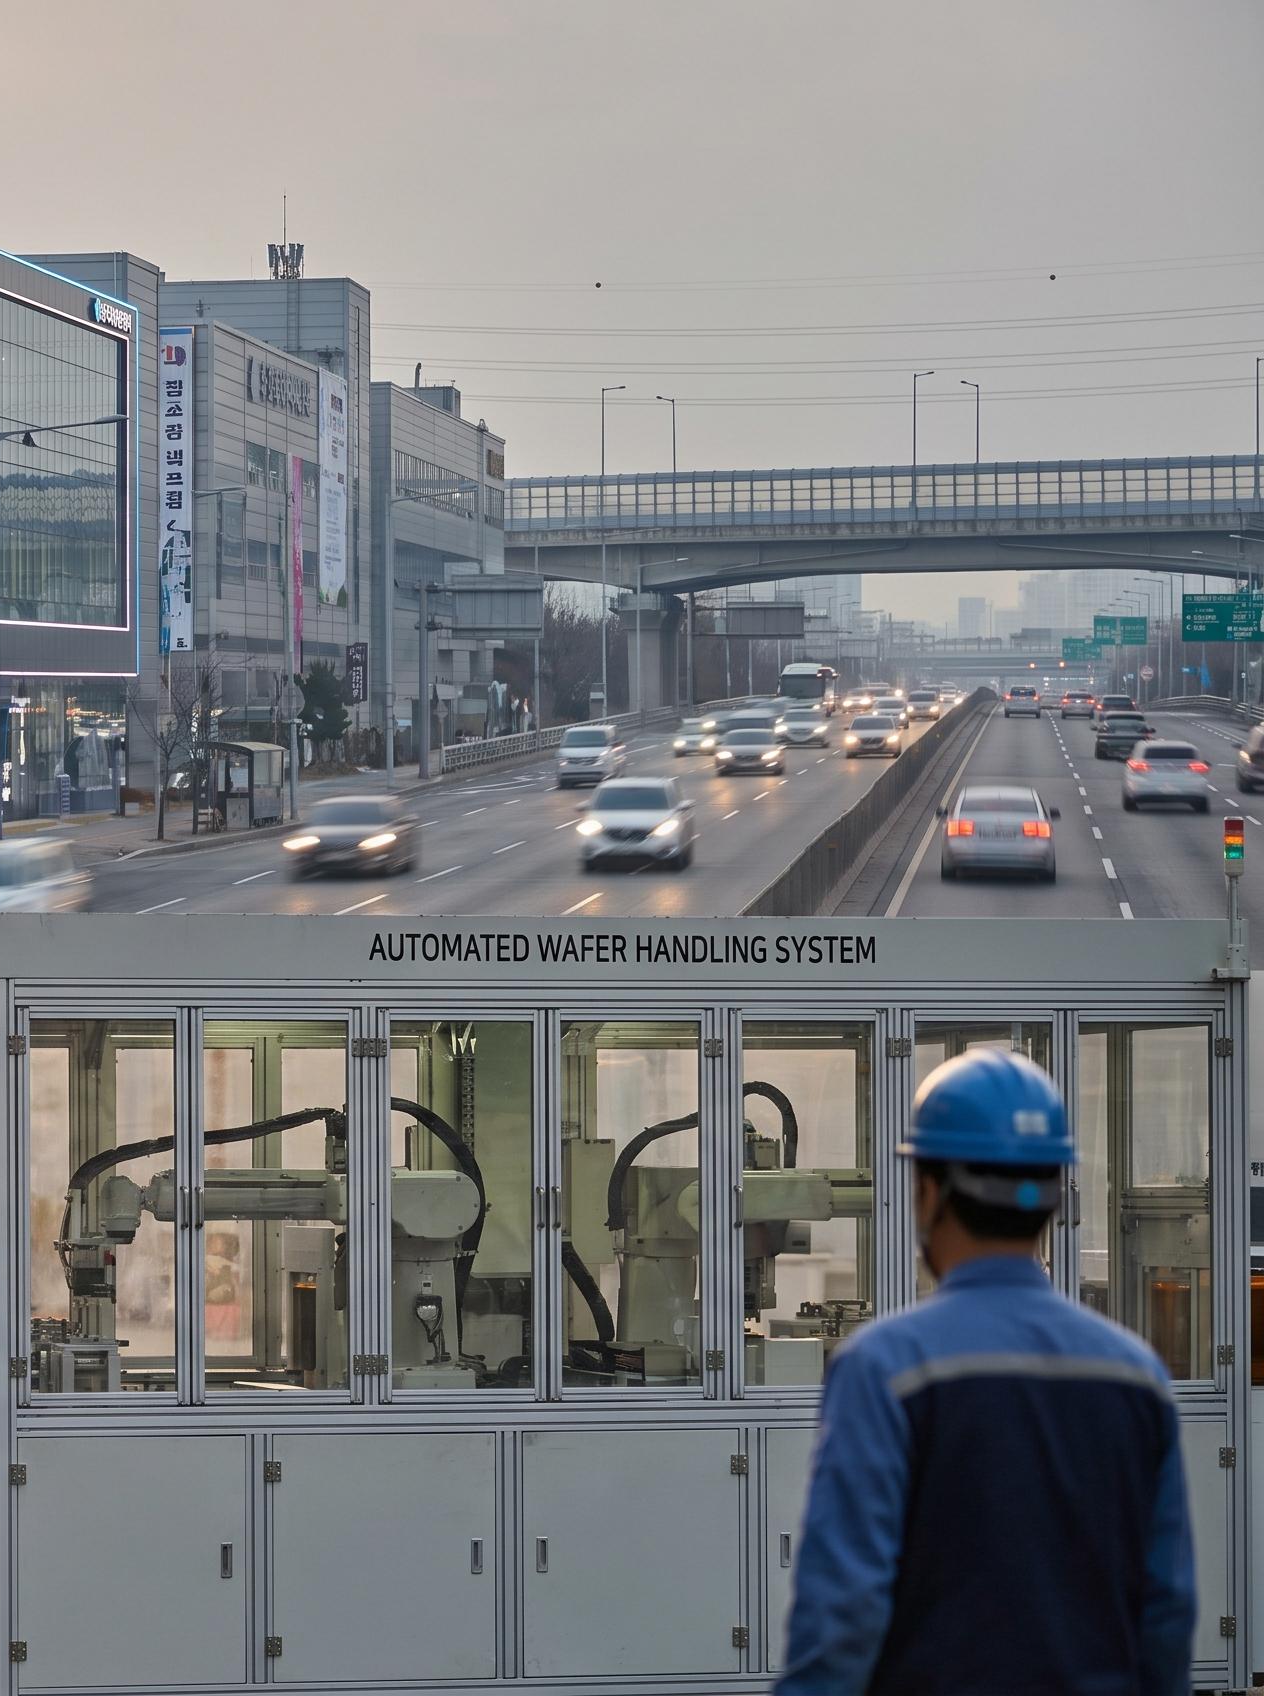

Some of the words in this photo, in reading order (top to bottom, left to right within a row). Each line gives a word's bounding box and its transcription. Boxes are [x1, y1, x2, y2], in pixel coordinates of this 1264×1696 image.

[369, 933, 530, 962] AUTOMATED
[537, 934, 627, 963] WAFER
[637, 935, 767, 964] HANDLING
[775, 935, 877, 964] SYSTEM
